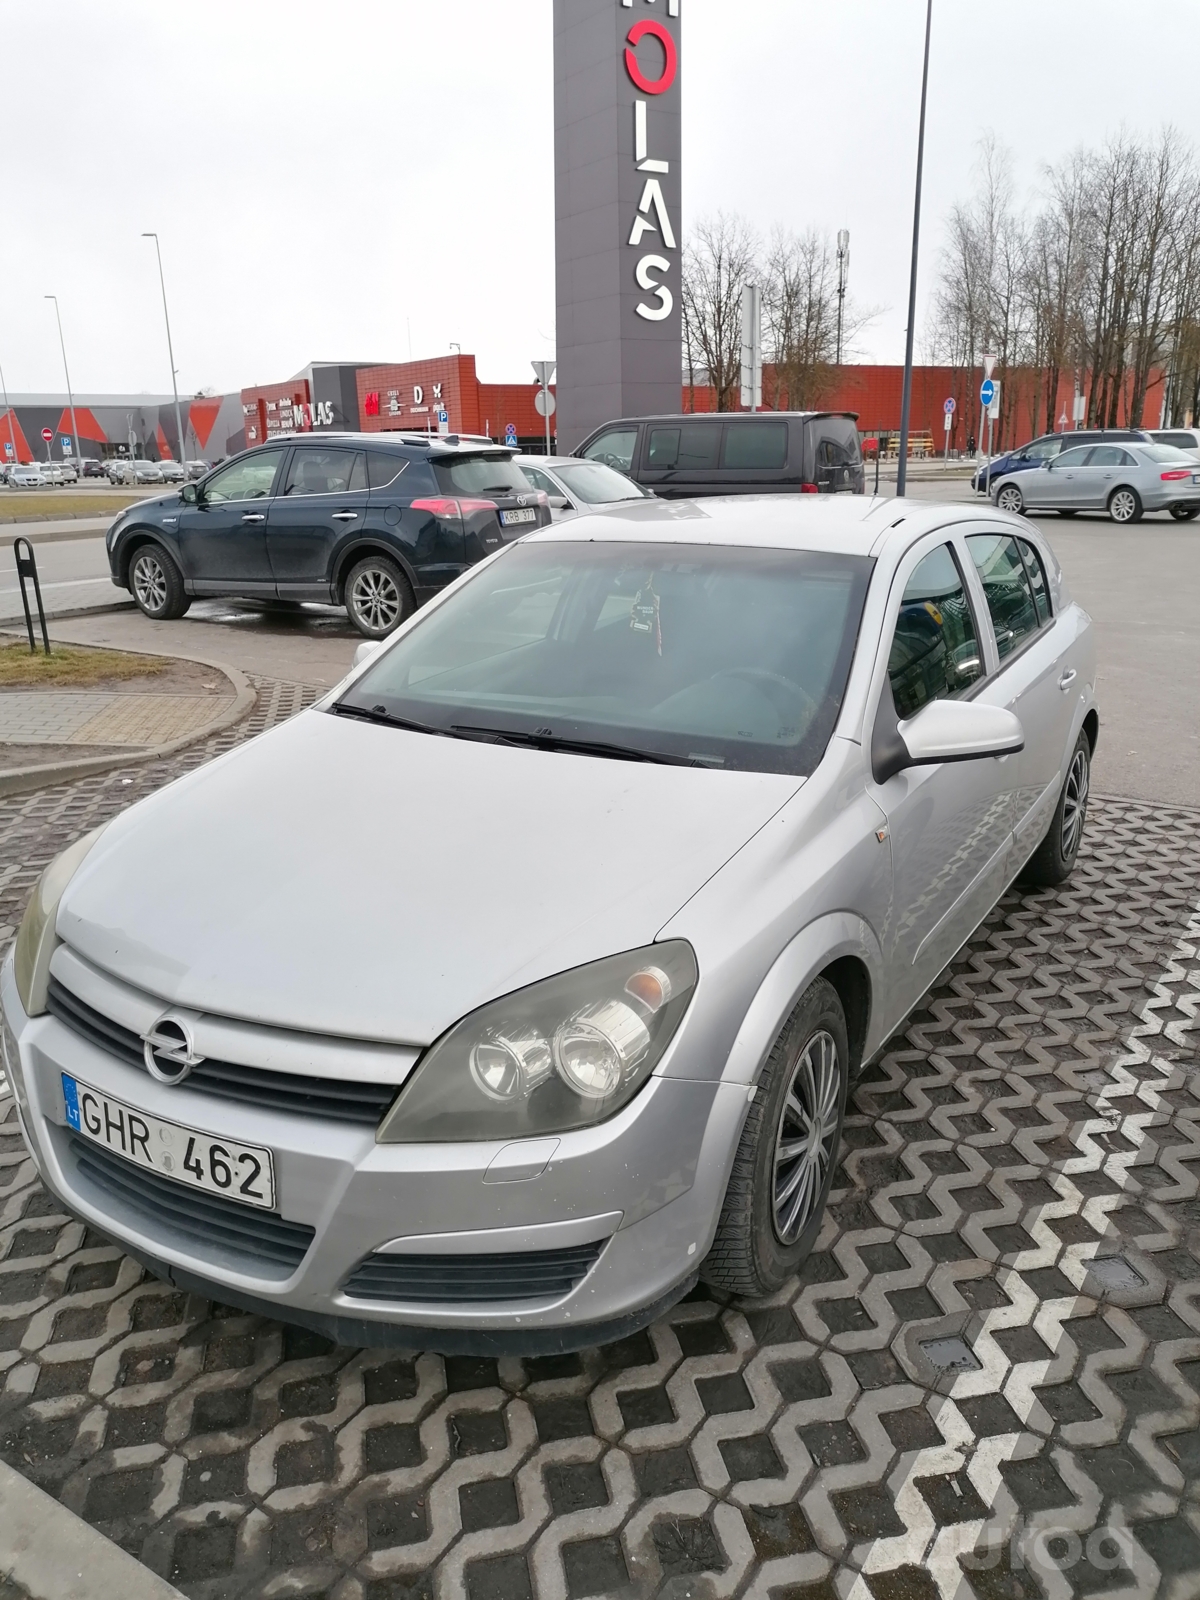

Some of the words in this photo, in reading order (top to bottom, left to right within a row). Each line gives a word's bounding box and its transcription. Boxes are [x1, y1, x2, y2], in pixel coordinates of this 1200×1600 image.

[622, 0, 679, 321] OLAS
[293, 401, 334, 427] MOLAS
[440, 412, 447, 422] P
[504, 511, 520, 523] KRB
[522, 509, 534, 521] 377
[67, 1105, 79, 1122] LT
[81, 1093, 154, 1163] GHR
[183, 1136, 264, 1200] 462
